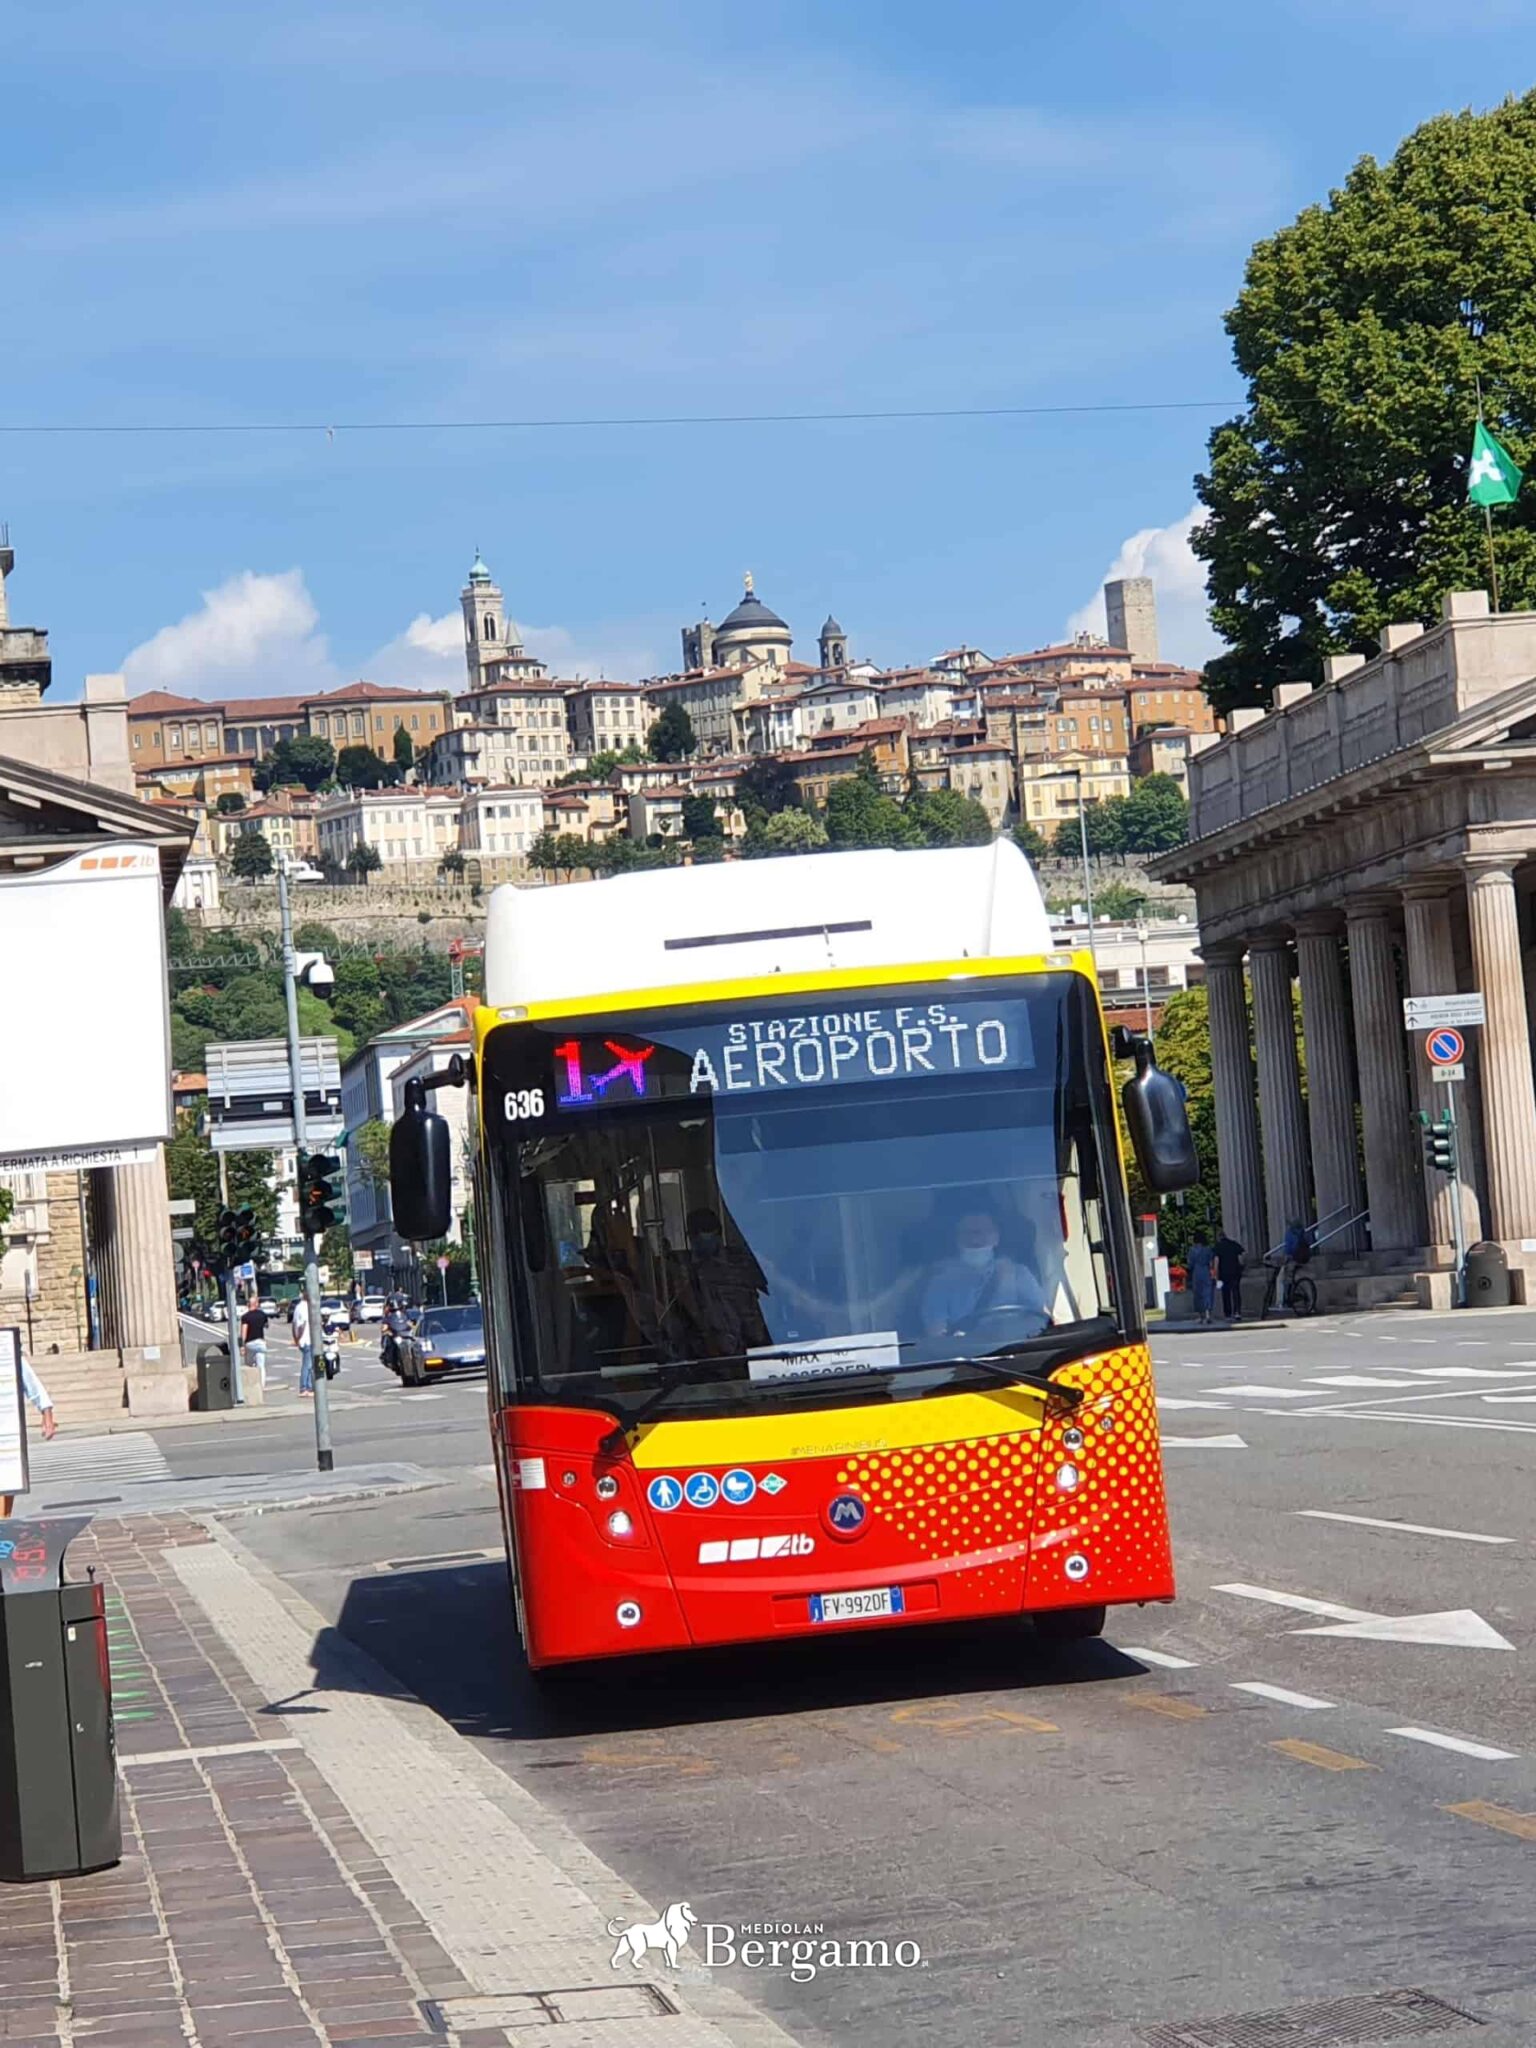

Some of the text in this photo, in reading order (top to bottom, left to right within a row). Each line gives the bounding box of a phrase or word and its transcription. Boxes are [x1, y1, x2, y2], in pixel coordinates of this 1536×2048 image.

[728, 1004, 959, 1044] STAZIONE F.S.
[554, 1041, 582, 1097] 1
[690, 1019, 1008, 1094] AEROPORTO
[504, 1088, 545, 1121] 636
[61, 1149, 121, 1165] RICHIESTA
[785, 1353, 820, 1366] MAX
